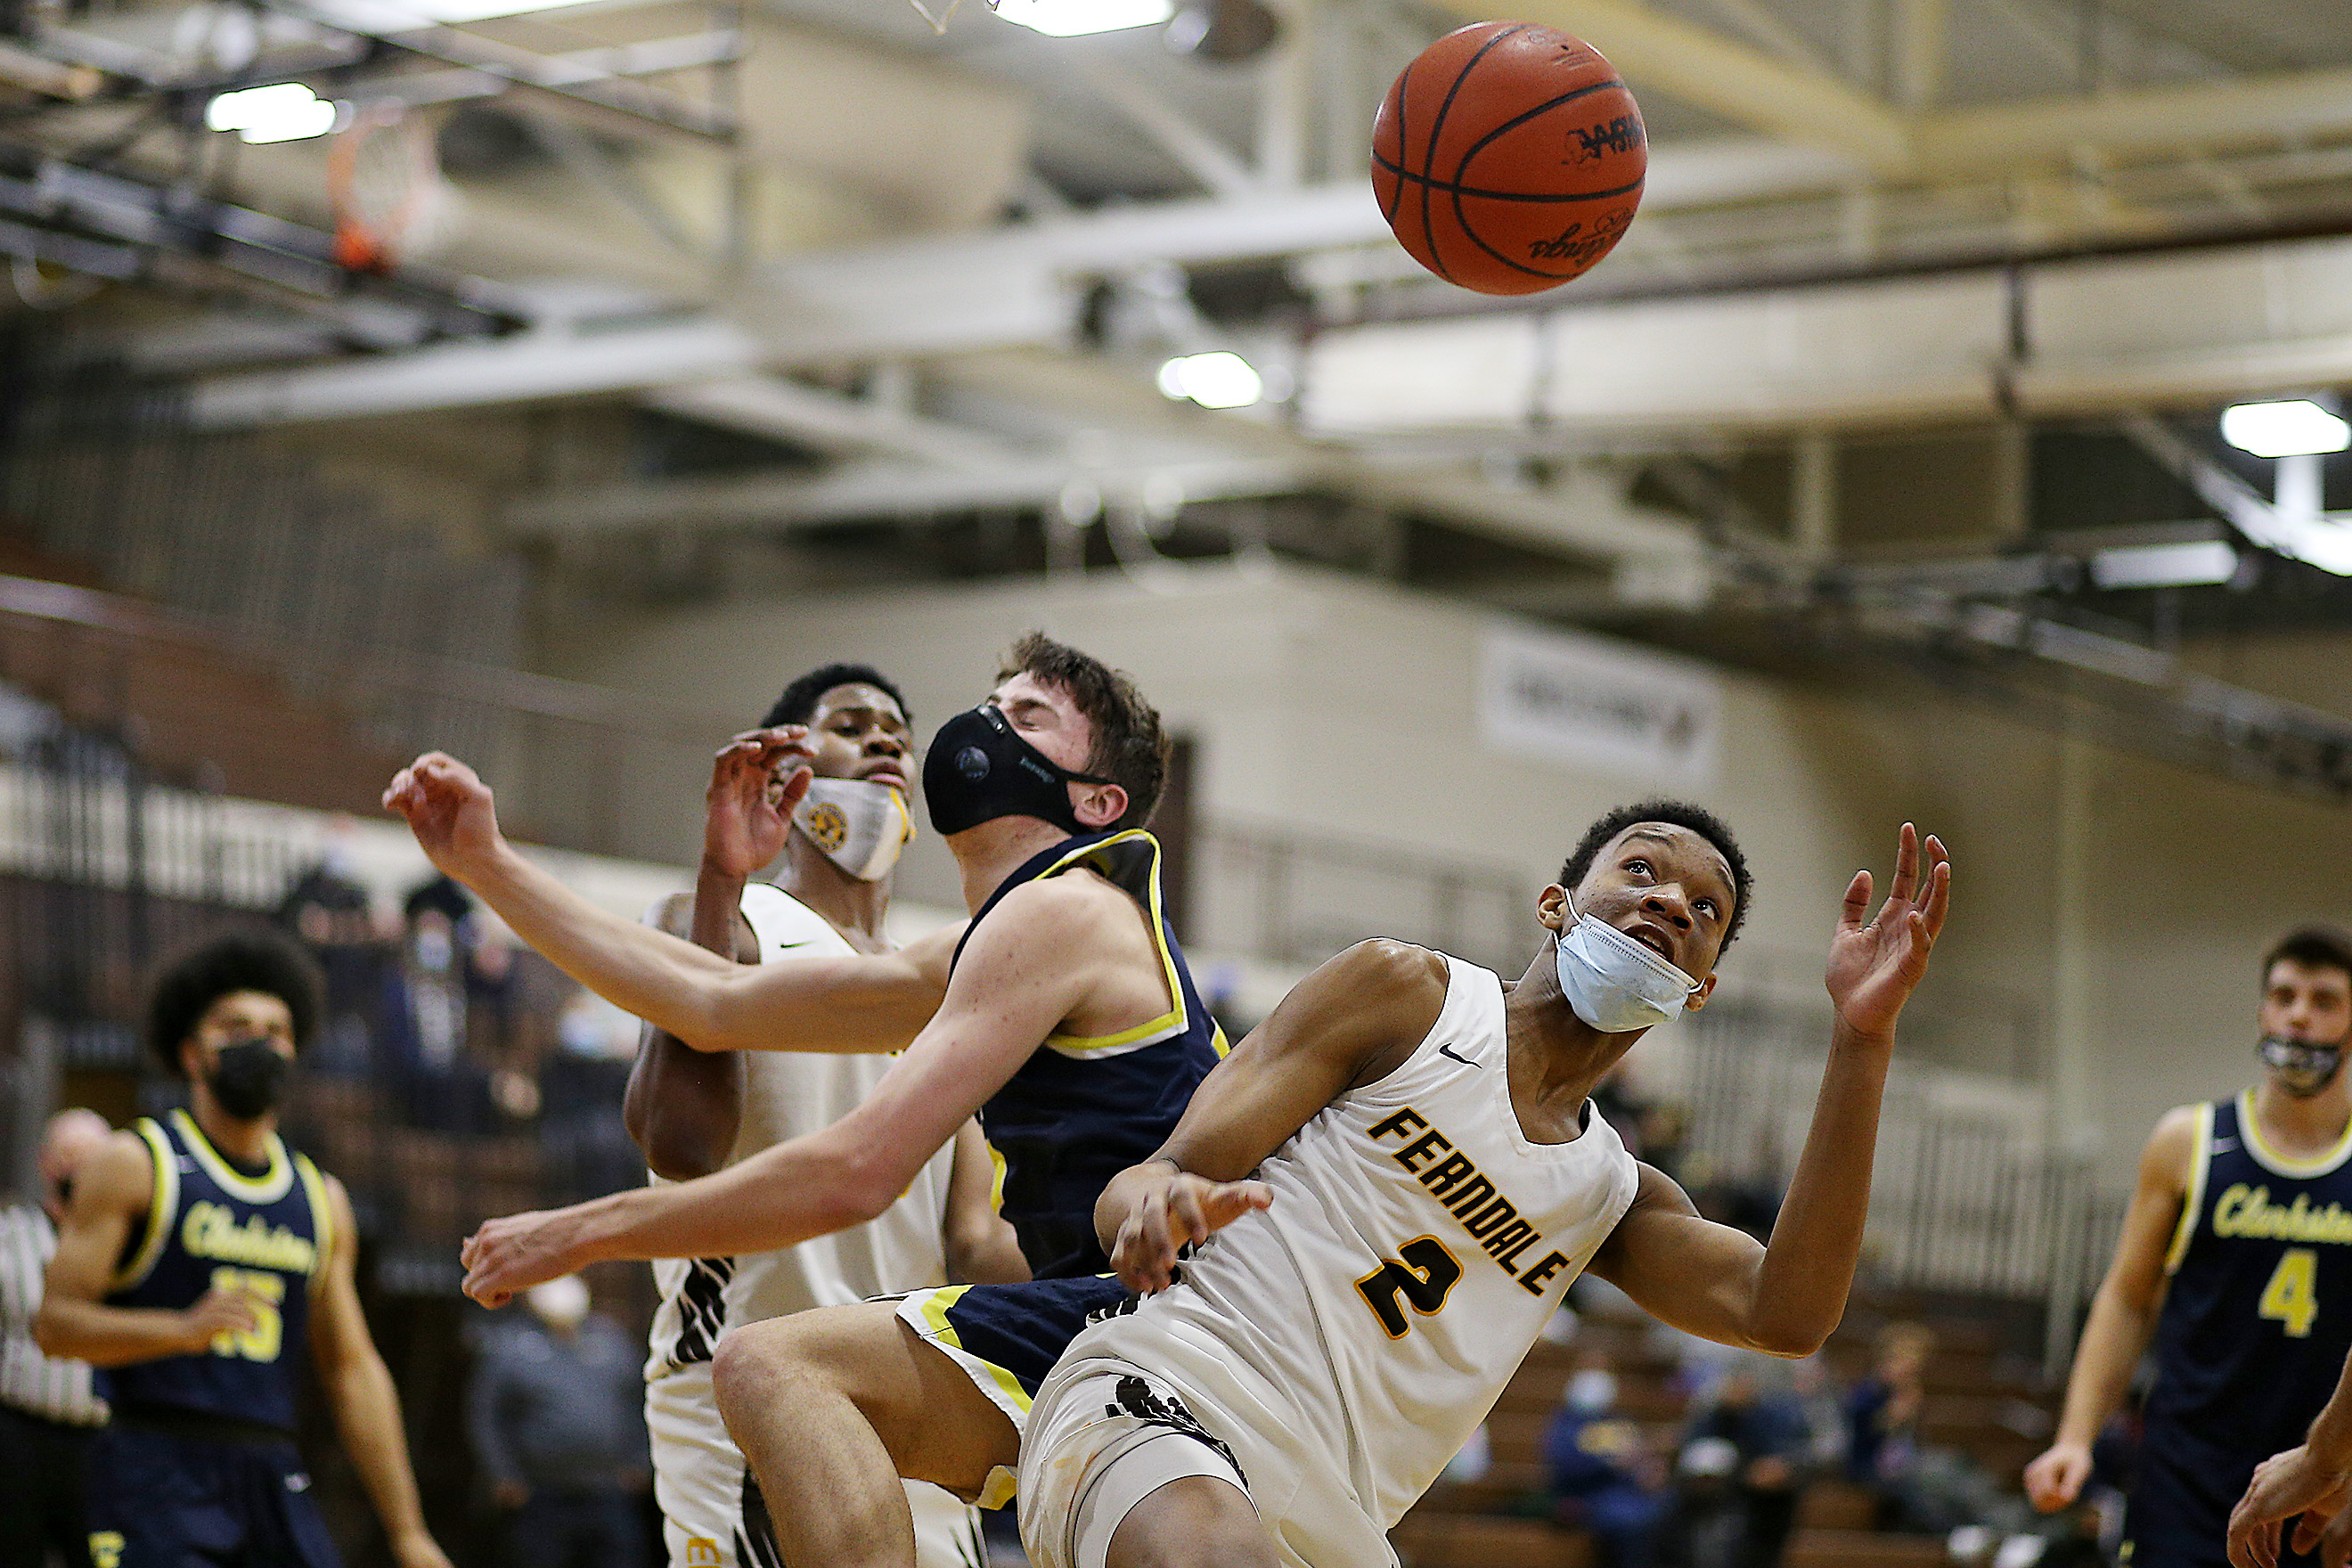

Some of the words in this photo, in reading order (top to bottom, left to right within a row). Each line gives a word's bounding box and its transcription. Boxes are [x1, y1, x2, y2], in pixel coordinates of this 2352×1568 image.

[1366, 1106, 1571, 1297] FERNDALE
[1353, 1234, 1465, 1340] 2
[2258, 1247, 2318, 1338] 4
